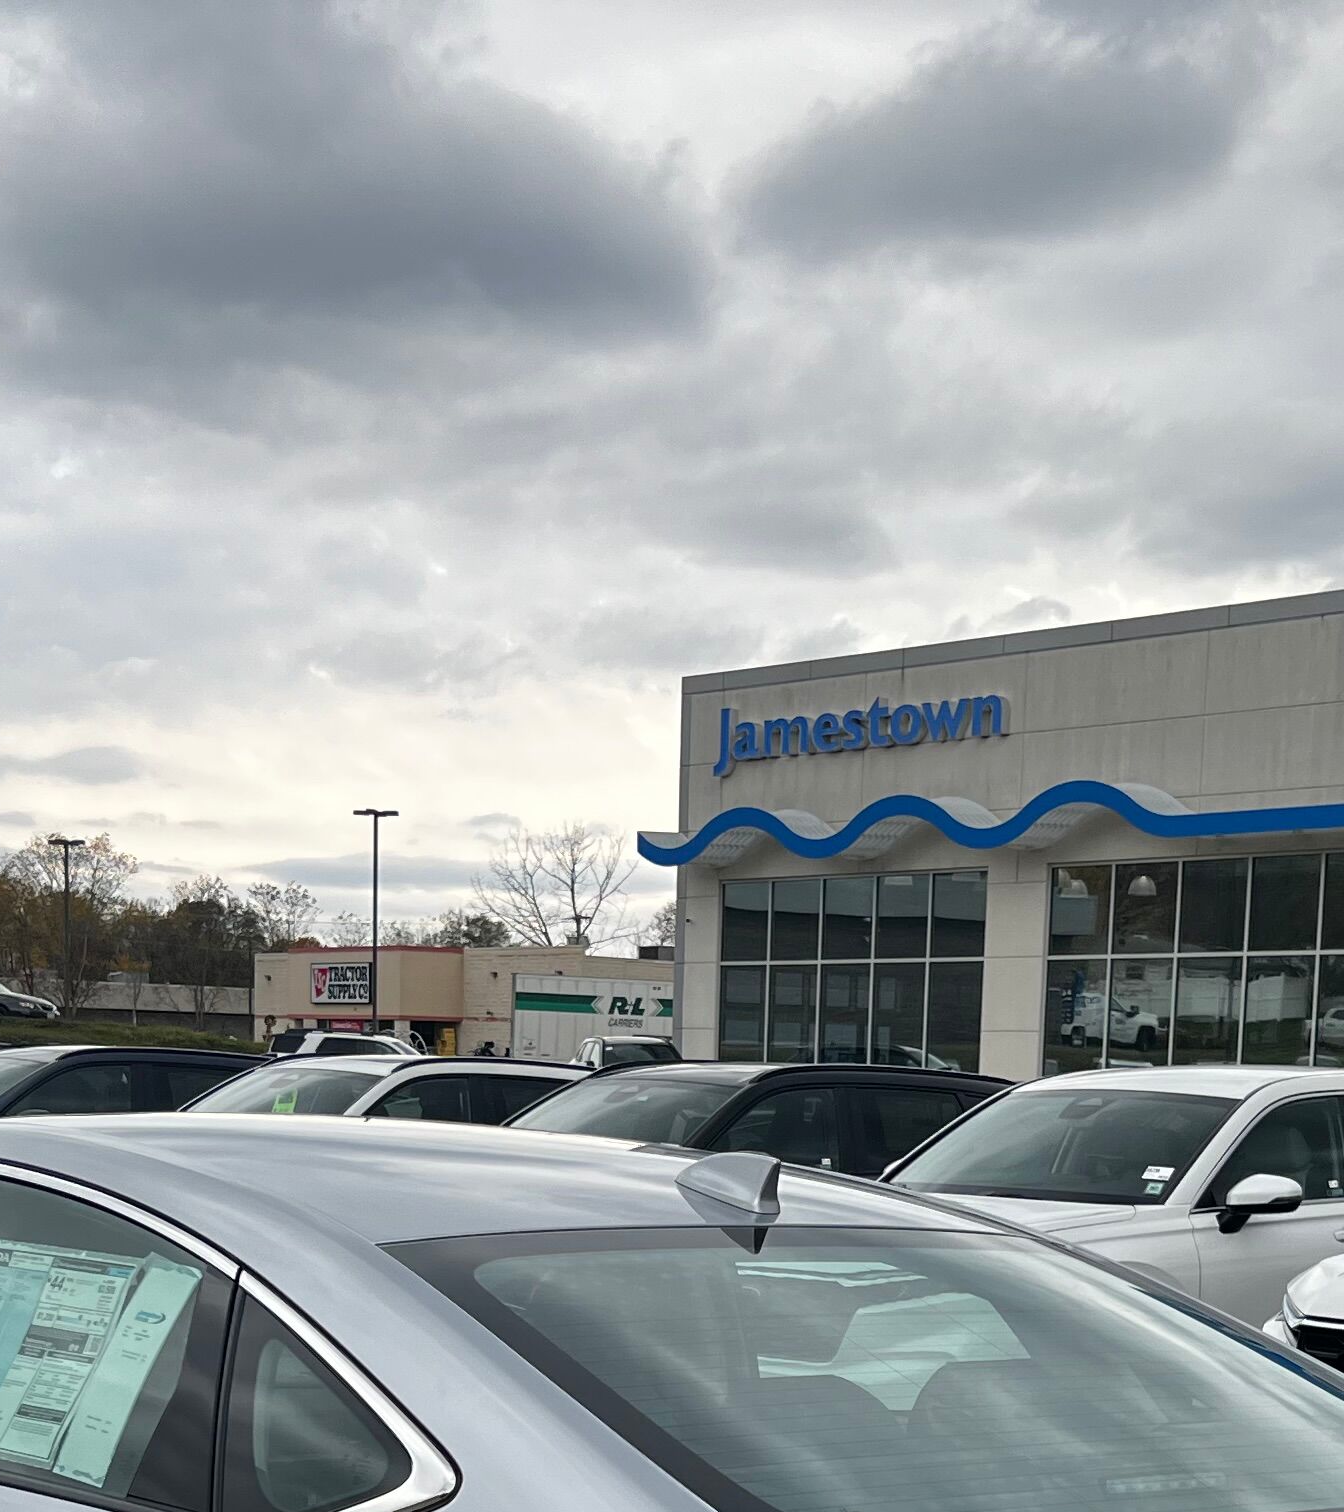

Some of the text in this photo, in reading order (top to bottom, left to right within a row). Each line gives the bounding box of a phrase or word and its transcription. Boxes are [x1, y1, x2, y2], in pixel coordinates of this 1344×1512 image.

[712, 693, 1010, 777] Jamestown
[328, 966, 368, 982] TRACTOR
[328, 983, 358, 1000] SUPPLY
